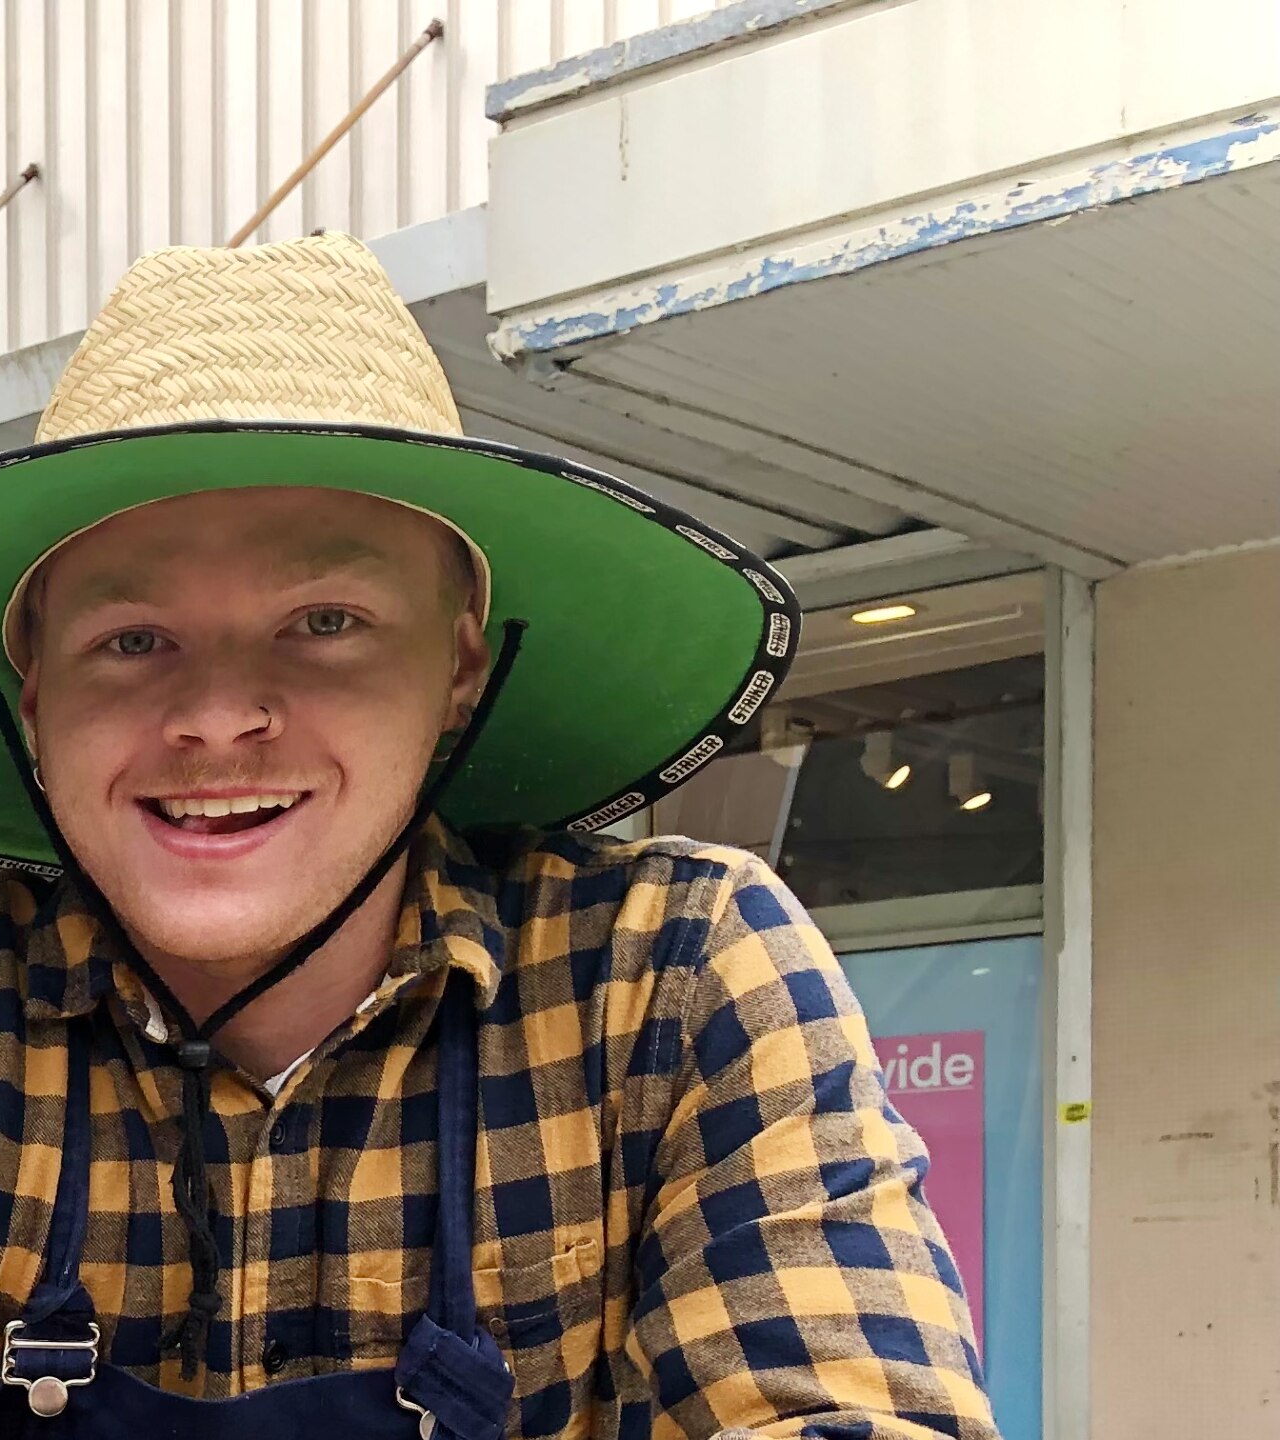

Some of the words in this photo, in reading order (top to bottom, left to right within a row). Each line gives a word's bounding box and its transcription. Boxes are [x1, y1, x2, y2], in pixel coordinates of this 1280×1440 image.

[731, 671, 772, 723] STRIKER
[662, 736, 721, 782] STRIKER
[570, 793, 642, 832] STRIKER
